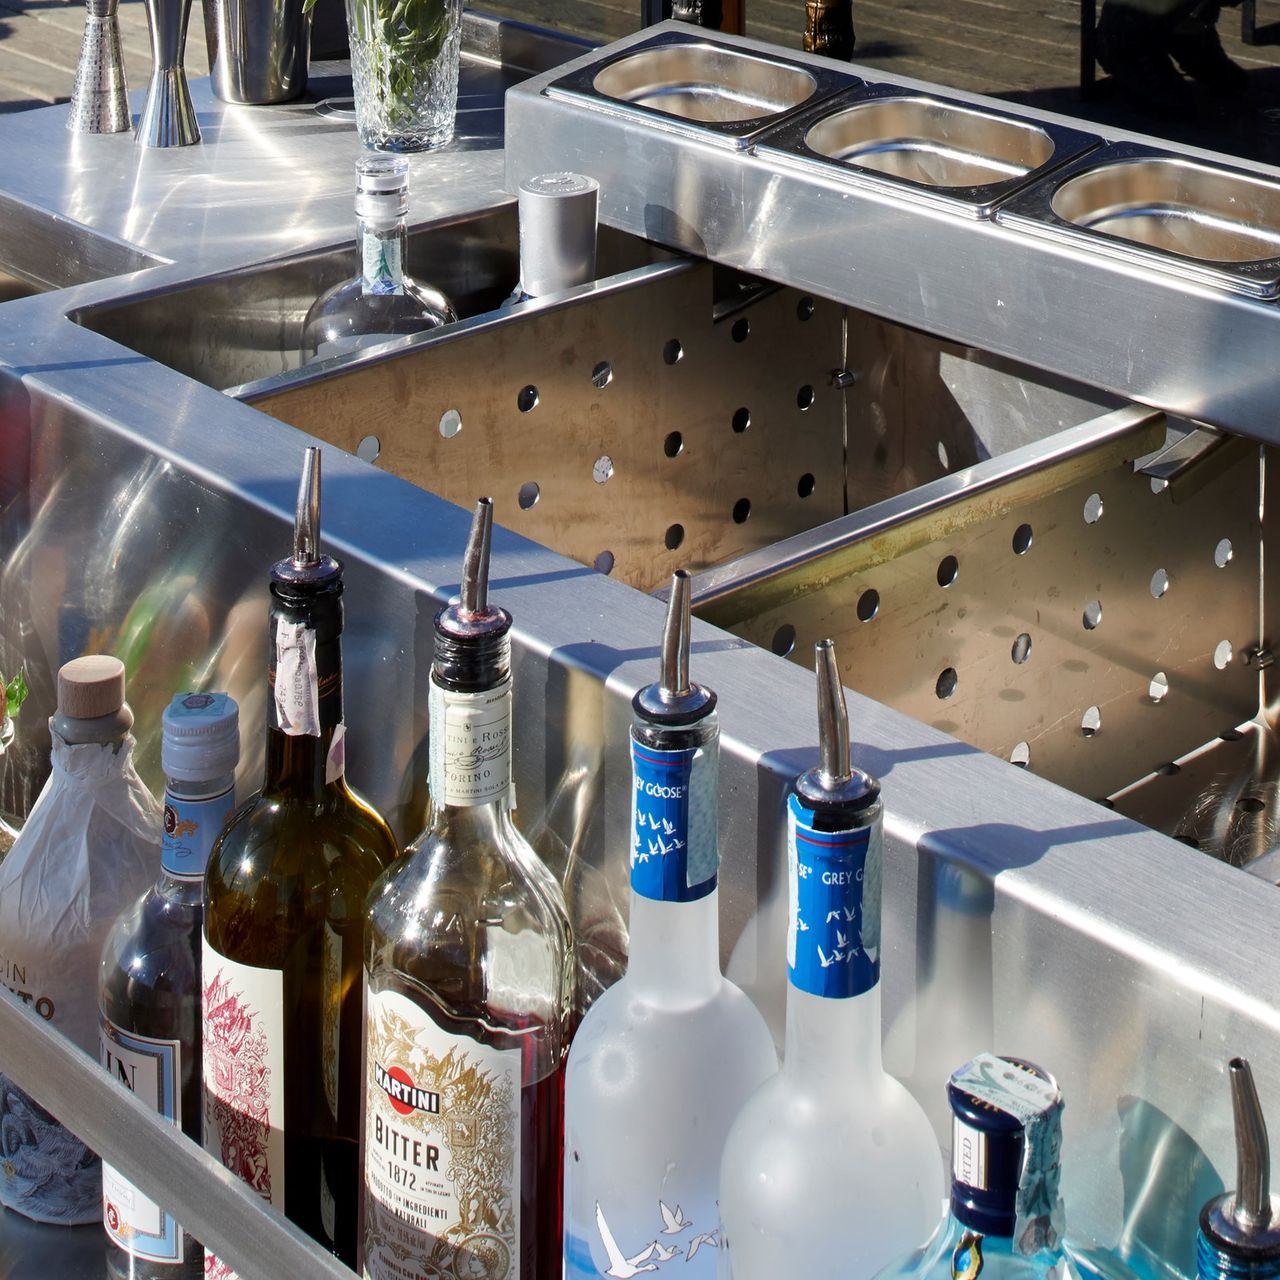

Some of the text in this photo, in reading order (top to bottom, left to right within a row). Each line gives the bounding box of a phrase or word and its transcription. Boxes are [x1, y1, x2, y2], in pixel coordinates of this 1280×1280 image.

[447, 734, 467, 744] TINI
[482, 725, 511, 742] ROSS
[645, 783, 683, 799] GOOSE
[821, 870, 852, 886] GREY
[375, 1065, 438, 1114] MARTINI
[375, 1115, 440, 1172] BITTER
[387, 1160, 417, 1192] 1872
[394, 1207, 427, 1229] NATURALI
[402, 1198, 448, 1220] INGREDIENTI
